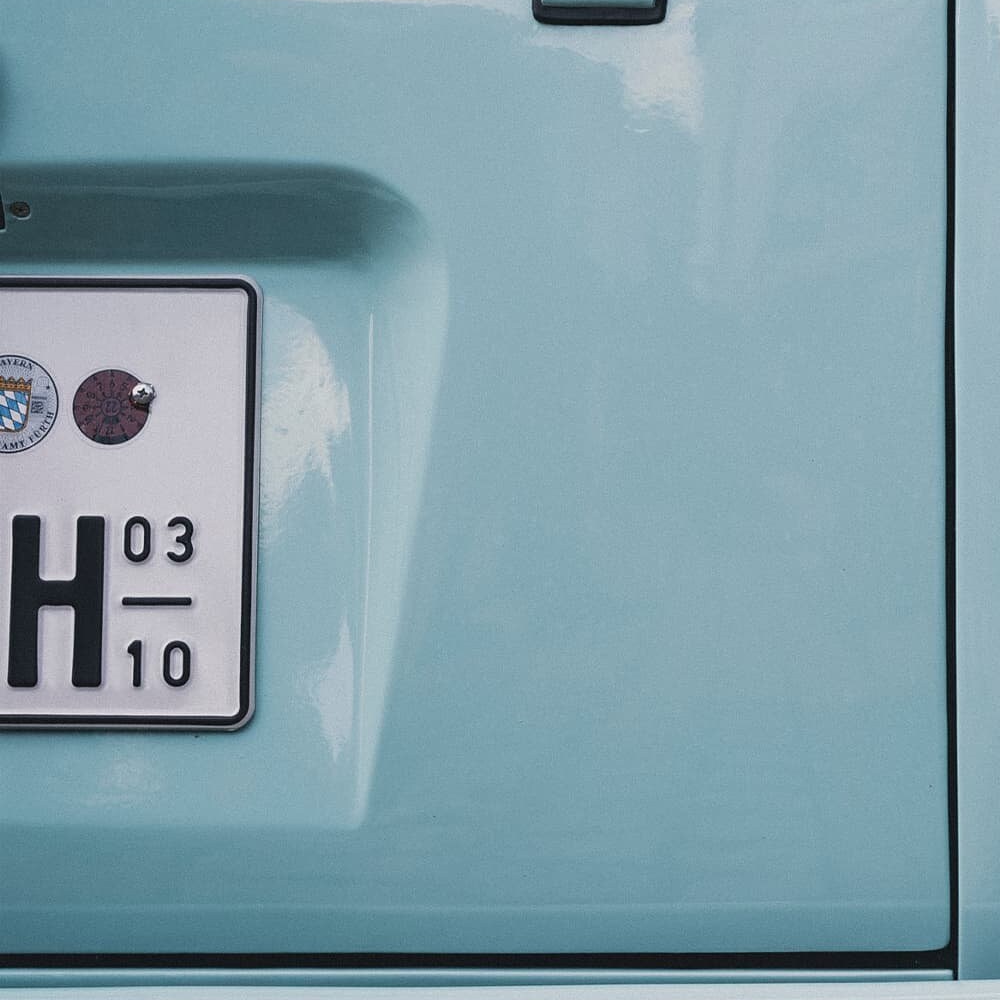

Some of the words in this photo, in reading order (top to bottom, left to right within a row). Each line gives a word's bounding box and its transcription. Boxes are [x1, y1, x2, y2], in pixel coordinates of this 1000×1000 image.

[124, 516, 193, 563] 03
[7, 515, 105, 688] H
[127, 640, 191, 687] 10
